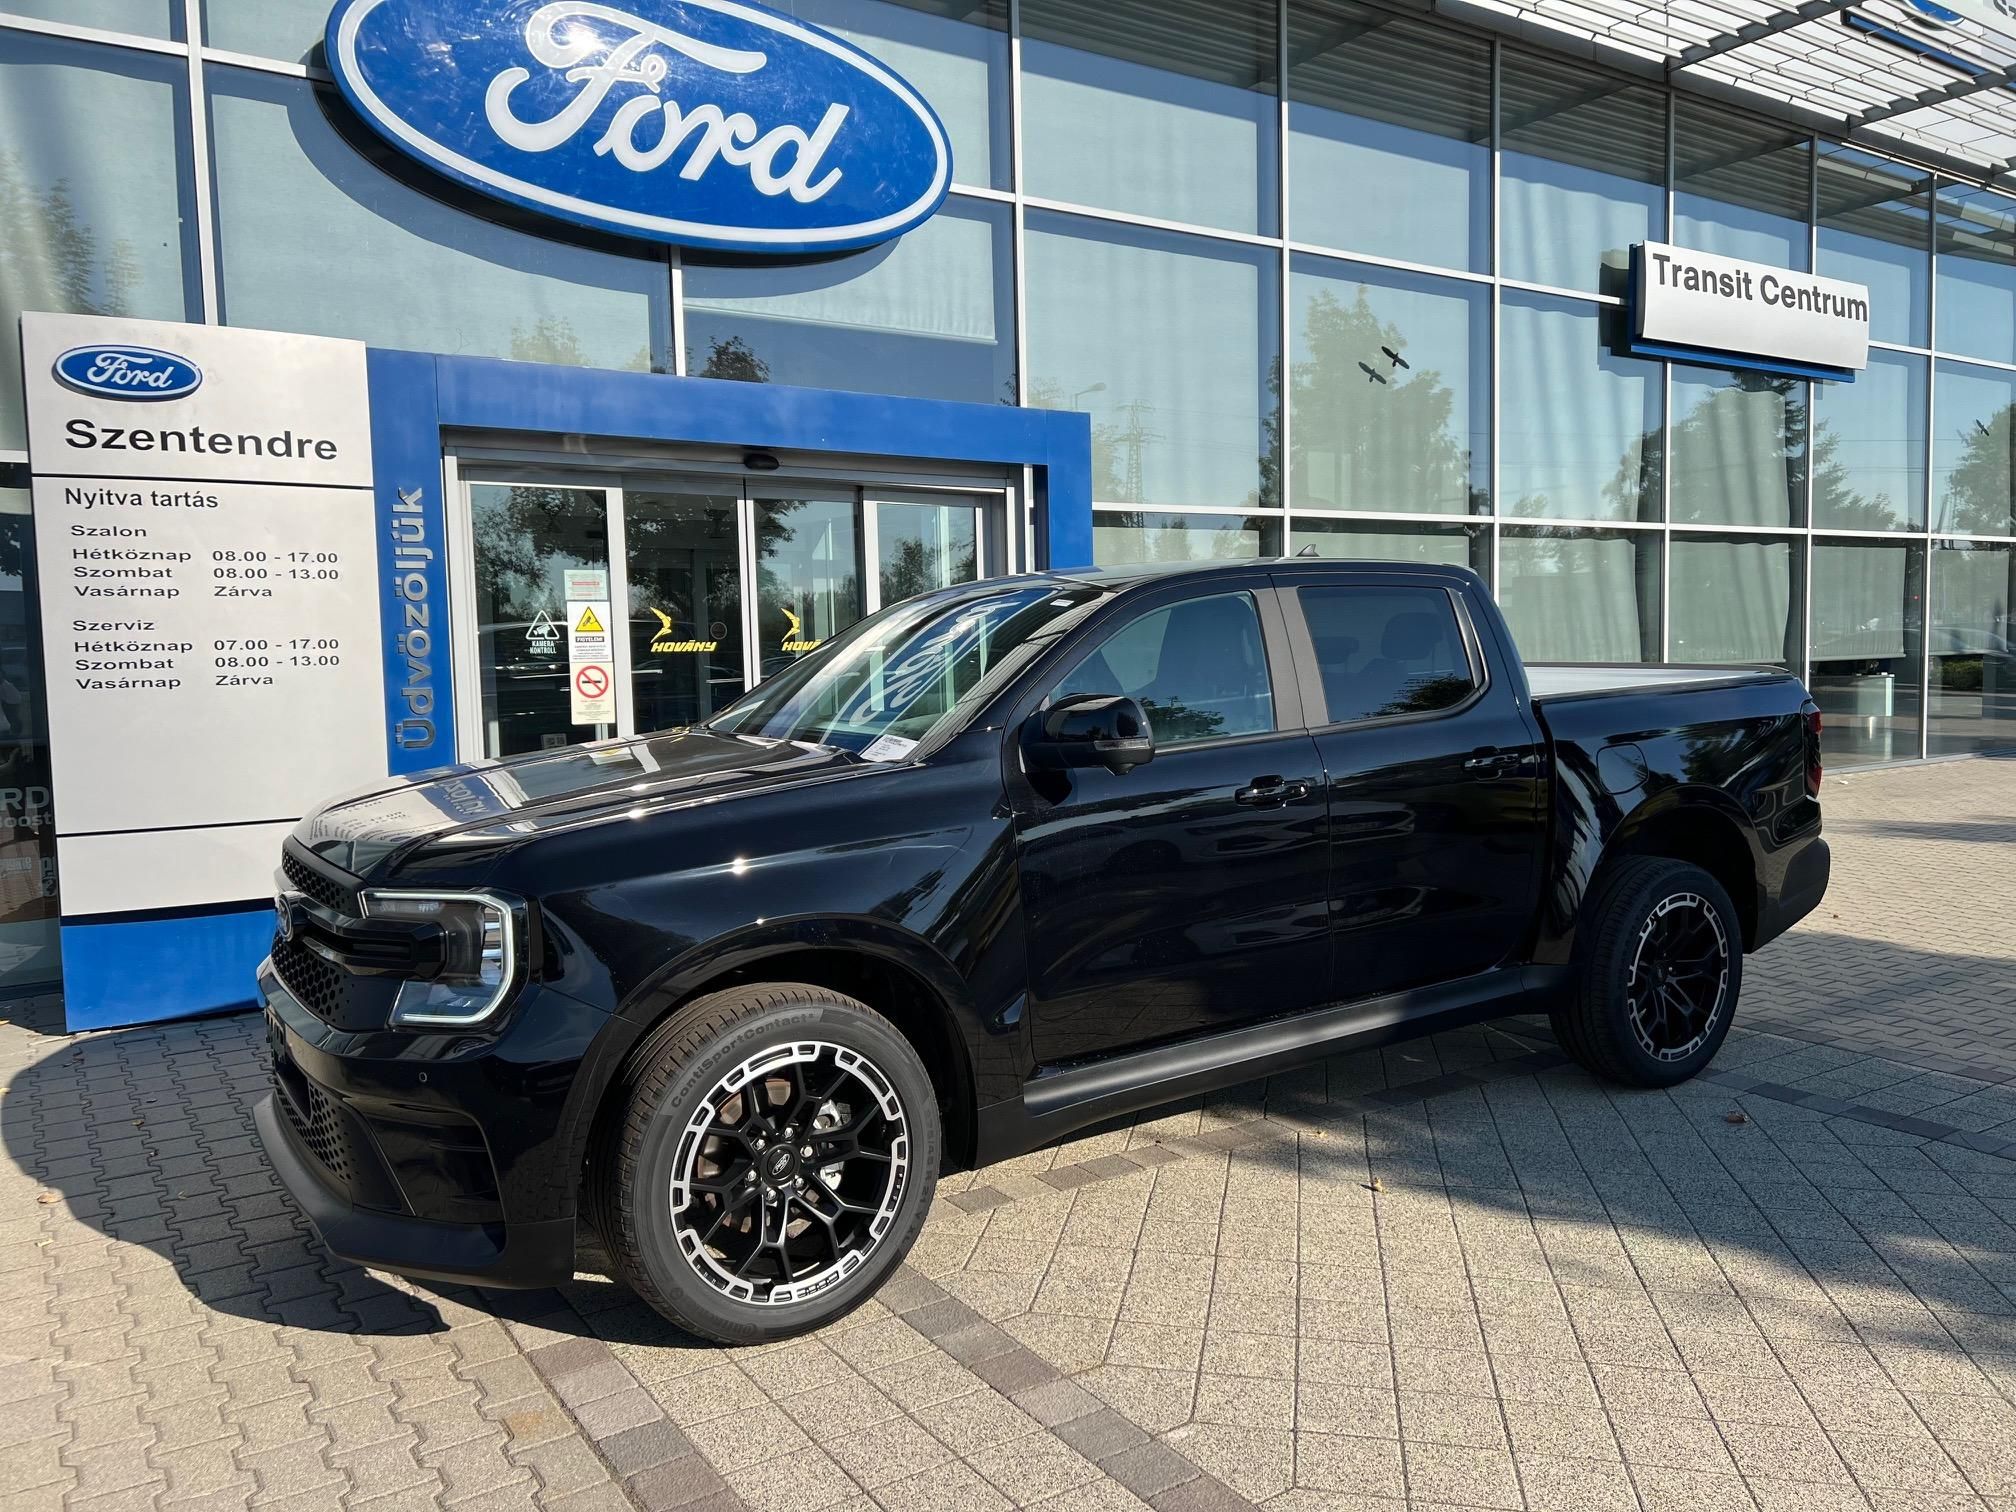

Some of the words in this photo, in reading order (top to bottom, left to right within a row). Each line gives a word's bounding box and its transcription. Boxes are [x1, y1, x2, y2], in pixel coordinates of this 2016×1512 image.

[485, 1, 850, 203] Ford
[1652, 253, 1753, 301] Transit
[1760, 274, 1868, 322] Centrum
[86, 352, 174, 389] Ford
[64, 418, 339, 461] Szentendre
[64, 487, 143, 510] Nyitva
[151, 490, 219, 508] tartás
[71, 525, 147, 537] Szalon
[72, 548, 192, 563] Hétköznap
[212, 550, 267, 562] 08.00
[287, 552, 338, 563] 17.00
[74, 566, 173, 578] Szombat
[213, 567, 268, 579] 08.00
[288, 568, 339, 580] 13.00
[74, 585, 180, 599] Vasárnap
[214, 585, 272, 597] Zárva
[391, 487, 436, 750] Üdvözöljük
[72, 620, 155, 631] Szerviz
[74, 640, 193, 653] Hétköznap
[214, 639, 268, 650] 07.00
[288, 638, 339, 650] 17.00
[529, 646, 557, 654] KONTROLL
[75, 657, 174, 671] Szombat
[215, 656, 269, 668] 08.00
[289, 655, 340, 666] 13.00
[75, 677, 181, 690] Vasárnap
[215, 675, 273, 686] Zárva
[0, 811, 53, 828] oost
